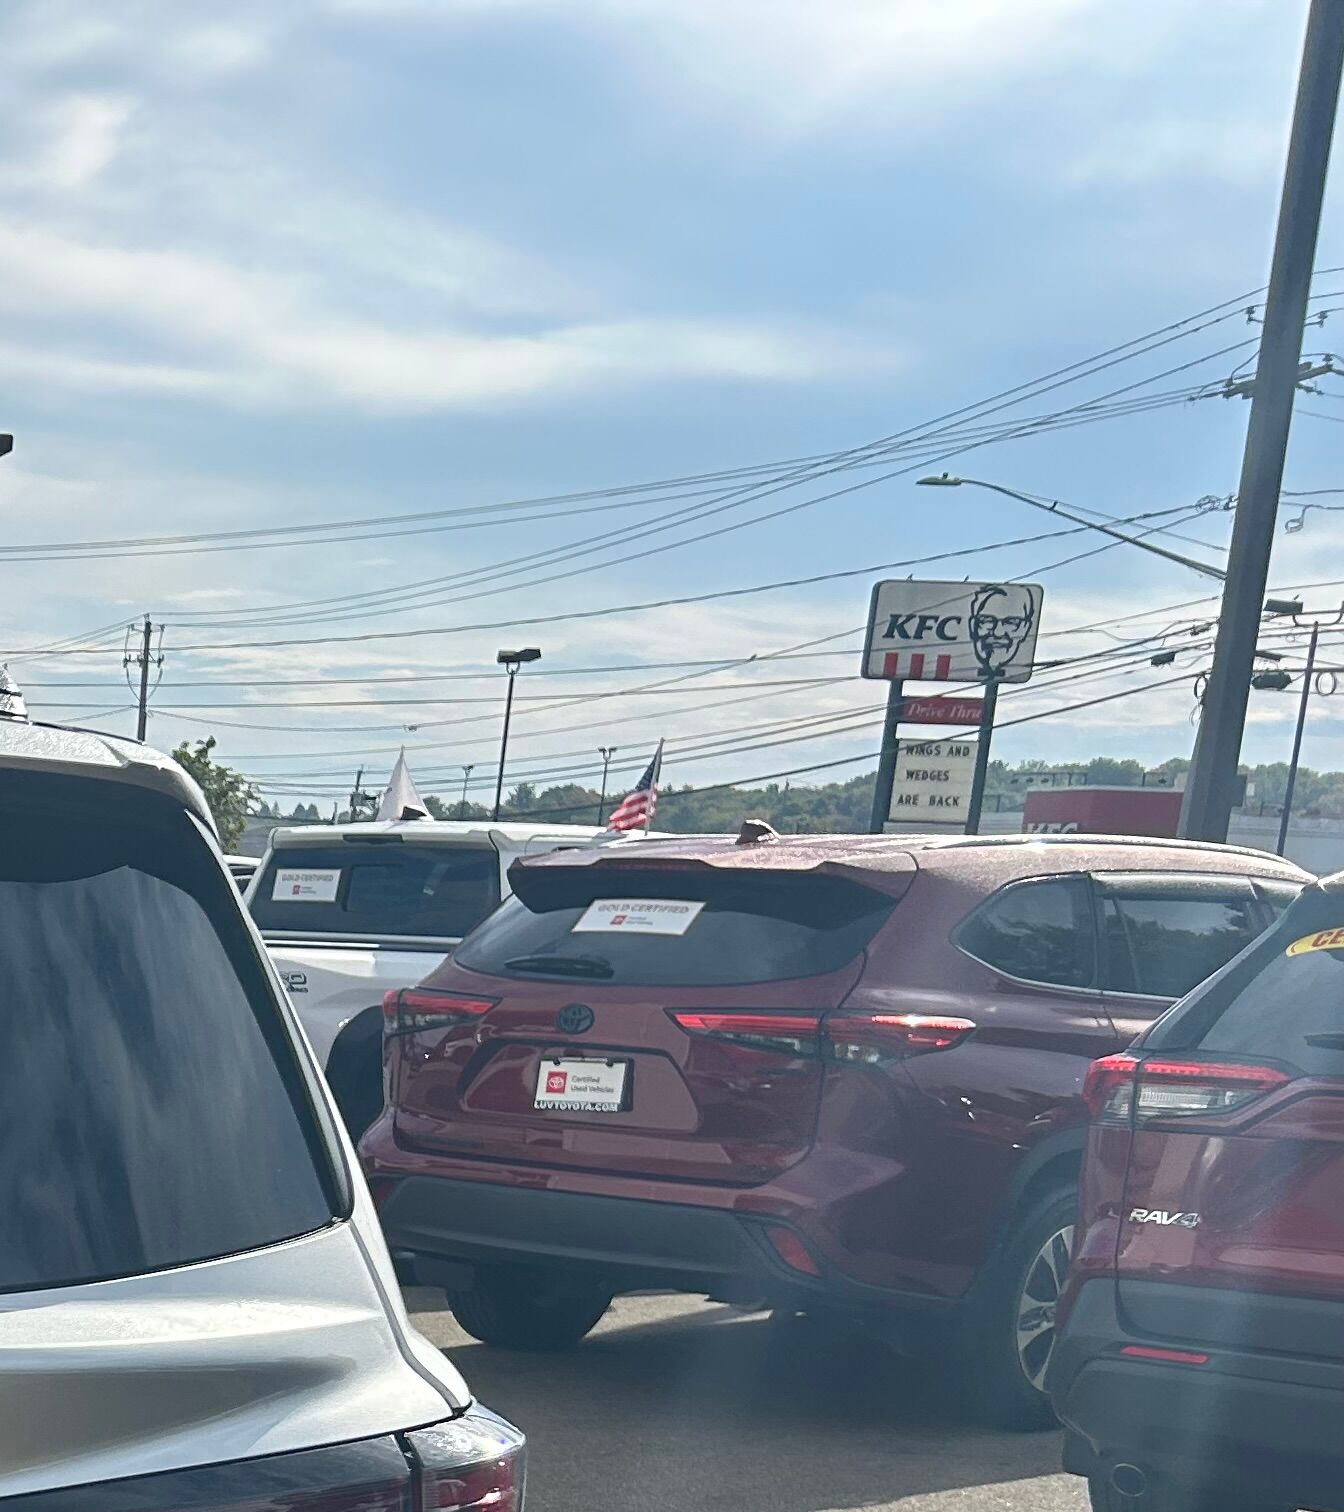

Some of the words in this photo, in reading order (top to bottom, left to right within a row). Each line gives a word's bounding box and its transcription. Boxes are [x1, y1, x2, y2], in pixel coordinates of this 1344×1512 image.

[882, 613, 962, 641] KFC
[907, 702, 945, 719] Drive
[949, 703, 982, 720] Thru
[905, 743, 942, 757] WINGS
[946, 747, 971, 757] AND
[905, 768, 950, 782] WEDGES
[897, 793, 920, 806] ARE
[928, 795, 961, 808] BACK
[533, 1101, 618, 1113] LUVTOYOTA.COM
[1128, 1208, 1200, 1228] RAV4
